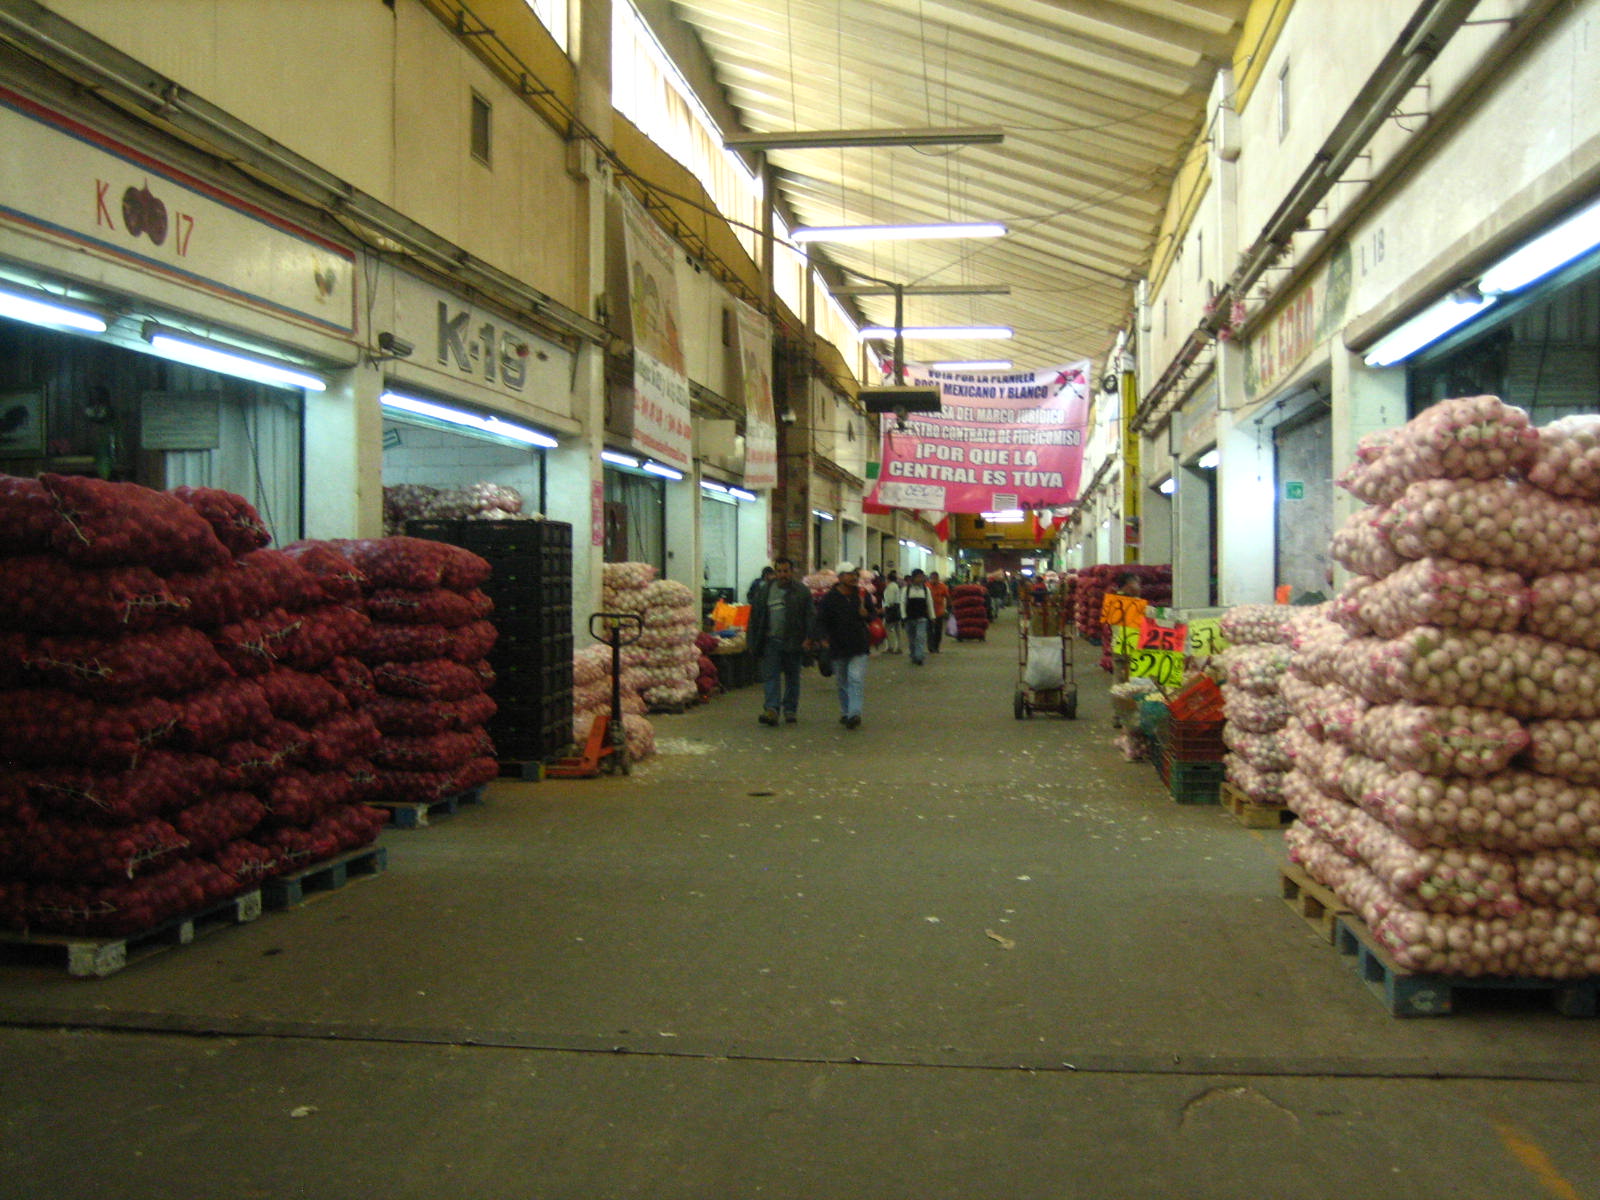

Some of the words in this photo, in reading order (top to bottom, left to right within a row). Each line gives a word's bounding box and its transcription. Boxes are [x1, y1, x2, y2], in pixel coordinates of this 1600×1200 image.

[95, 178, 115, 231] K
[175, 211, 195, 258] 17
[943, 382, 997, 399] MEXICANO
[999, 386, 1006, 399] Y
[1007, 385, 1049, 400] BLANCO
[957, 405, 974, 422] DEL
[976, 407, 1015, 424] MARCO
[942, 424, 996, 443] CONTRATO
[998, 428, 1013, 444] DE
[969, 447, 1009, 466] QUE
[1013, 449, 1038, 467] LA
[888, 461, 978, 485] CENTRAL
[982, 470, 1008, 487] ES
[1012, 471, 1065, 488] TUYA
[1142, 629, 1176, 651] 25
